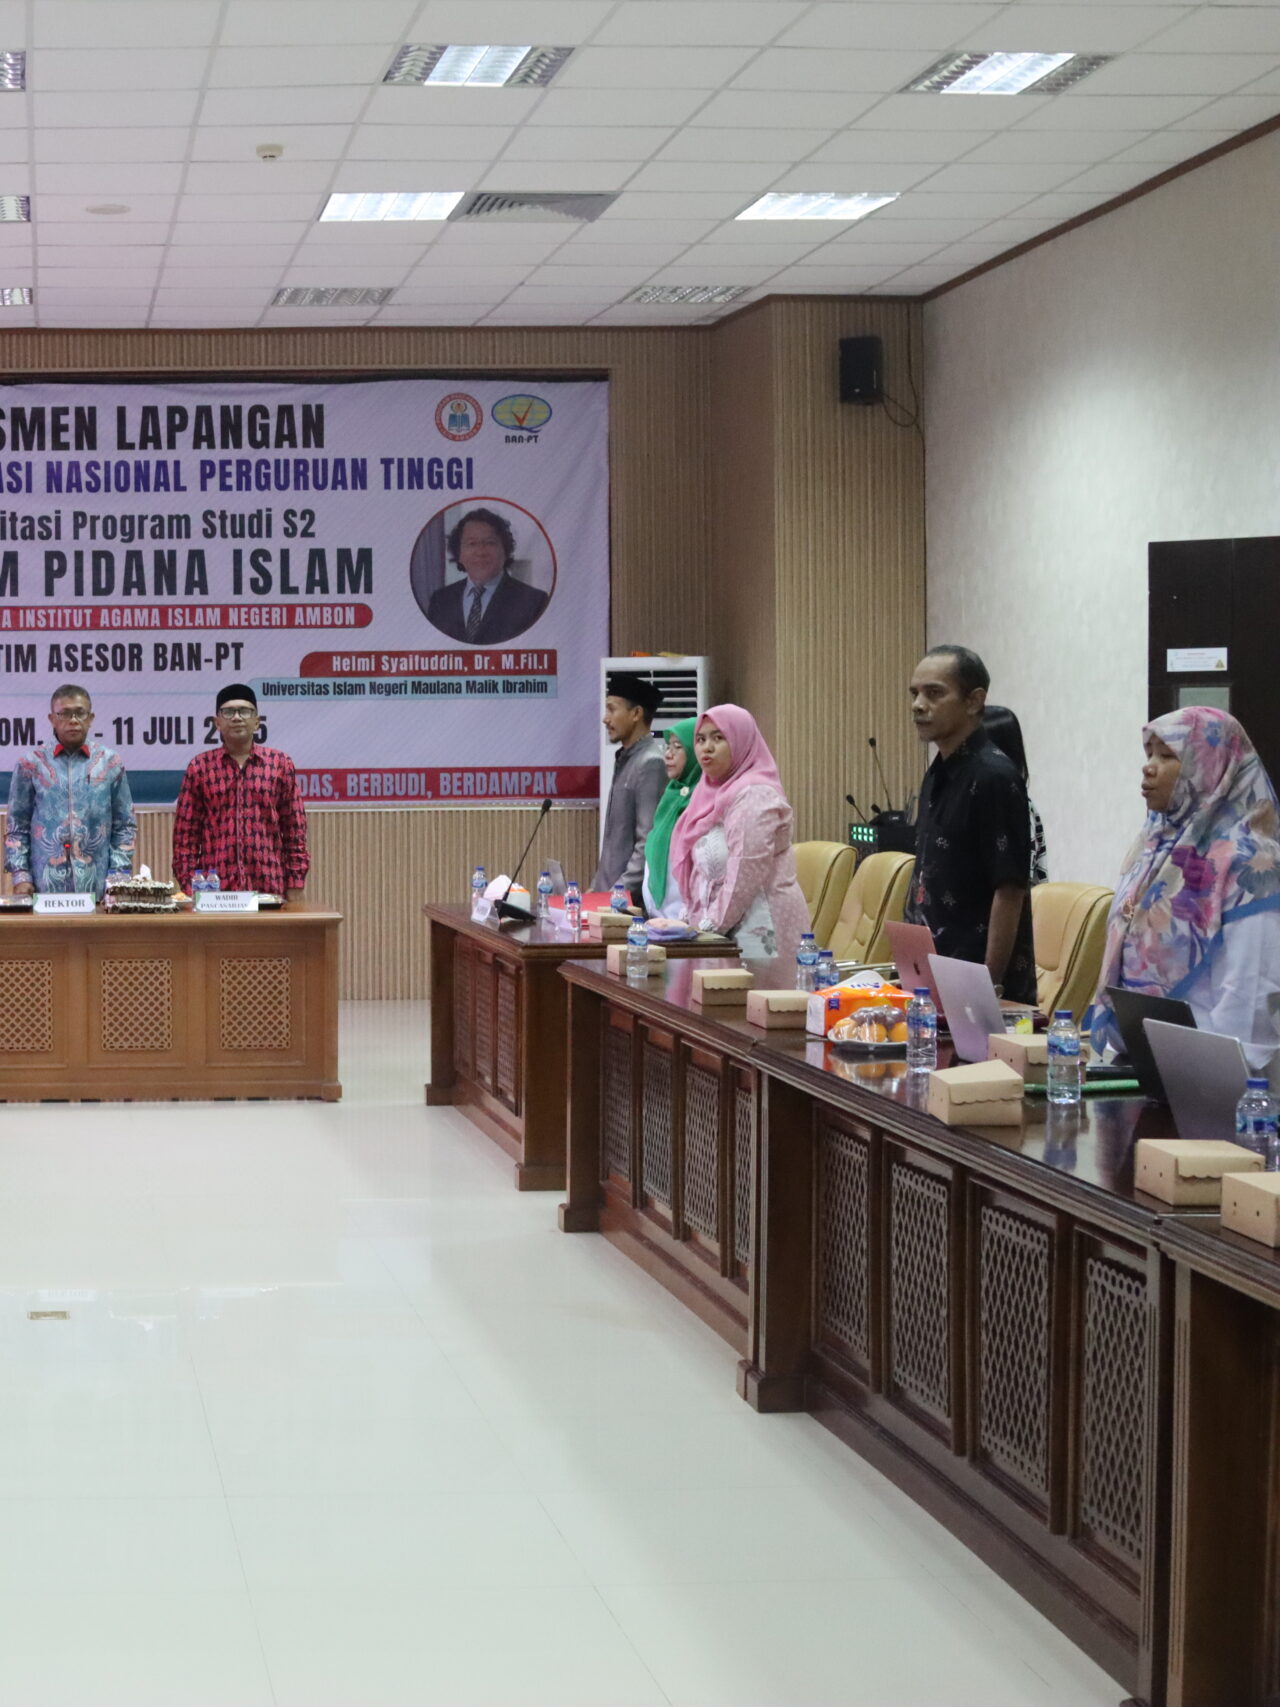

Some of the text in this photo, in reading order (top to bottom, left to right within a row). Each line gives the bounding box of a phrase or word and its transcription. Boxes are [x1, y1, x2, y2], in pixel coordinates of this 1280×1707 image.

[116, 404, 325, 451] LAPANGAN
[46, 459, 187, 494] NASIONAL
[200, 458, 368, 492] PERGURUAN
[381, 457, 474, 490] TINGGI
[73, 510, 191, 543] Program
[202, 508, 273, 539] Studi
[283, 509, 316, 539] S2
[44, 549, 209, 597] PIDANA
[232, 547, 374, 596] ISLAM
[20, 608, 92, 628] INSTITUT
[100, 608, 160, 627] AGAMA
[168, 607, 221, 627] ISLAM
[228, 606, 287, 626] NEGERI
[294, 606, 355, 625] AMBON
[48, 642, 143, 673] ASESOR
[153, 642, 244, 672] BAN-PT
[332, 654, 375, 672] Helmi
[381, 653, 468, 673] Syaifuddin,
[474, 653, 495, 671] Dr.
[262, 678, 548, 698] Universitas Islam Negeri Maulana Malik Ibrahim
[112, 717, 134, 745] 11
[143, 716, 194, 745] JULI
[204, 715, 268, 744] 25
[347, 772, 432, 799] BERBUDI,
[440, 771, 558, 796] BERDAMPAK
[44, 899, 85, 908] REKTOR
